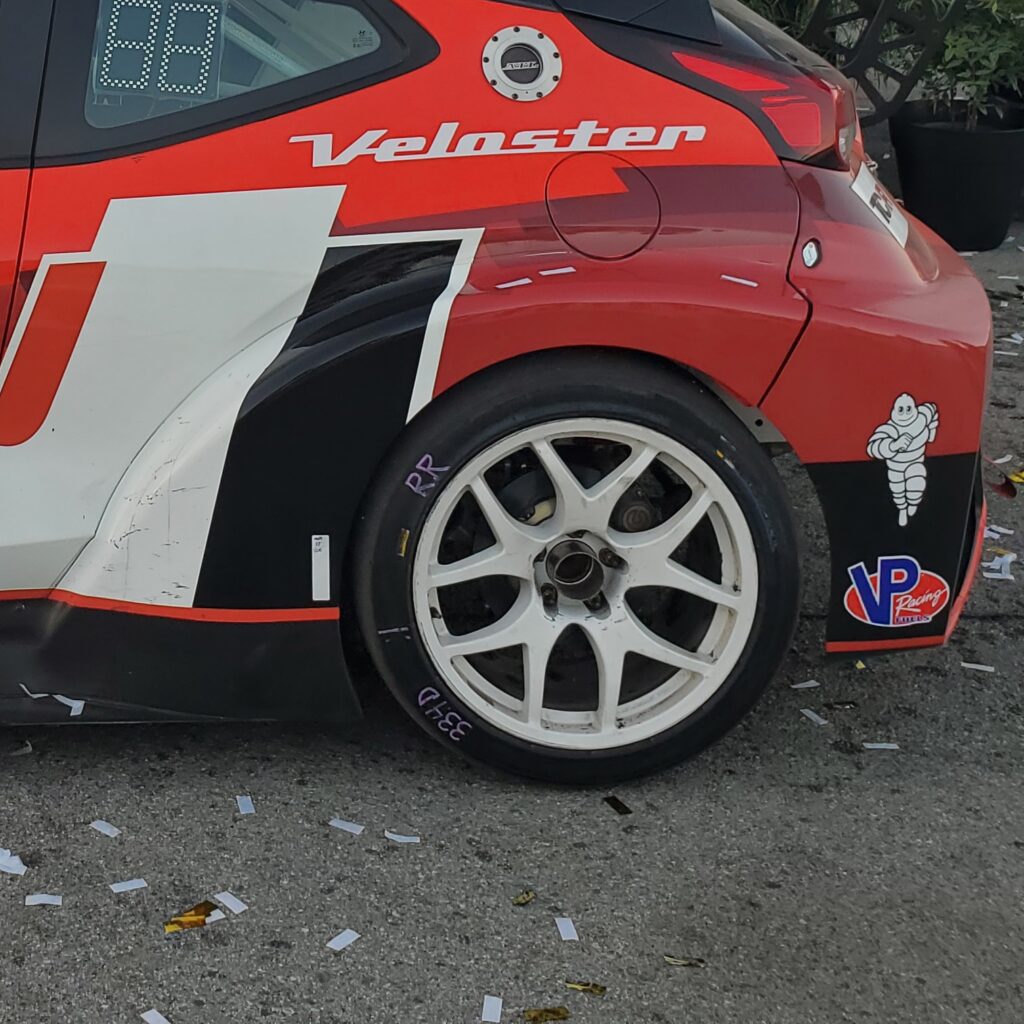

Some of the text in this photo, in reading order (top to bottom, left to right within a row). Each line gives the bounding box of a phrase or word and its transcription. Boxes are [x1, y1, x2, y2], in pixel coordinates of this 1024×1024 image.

[289, 119, 707, 168] Veloster
[847, 555, 921, 627] VP
[895, 587, 948, 617] Racing
